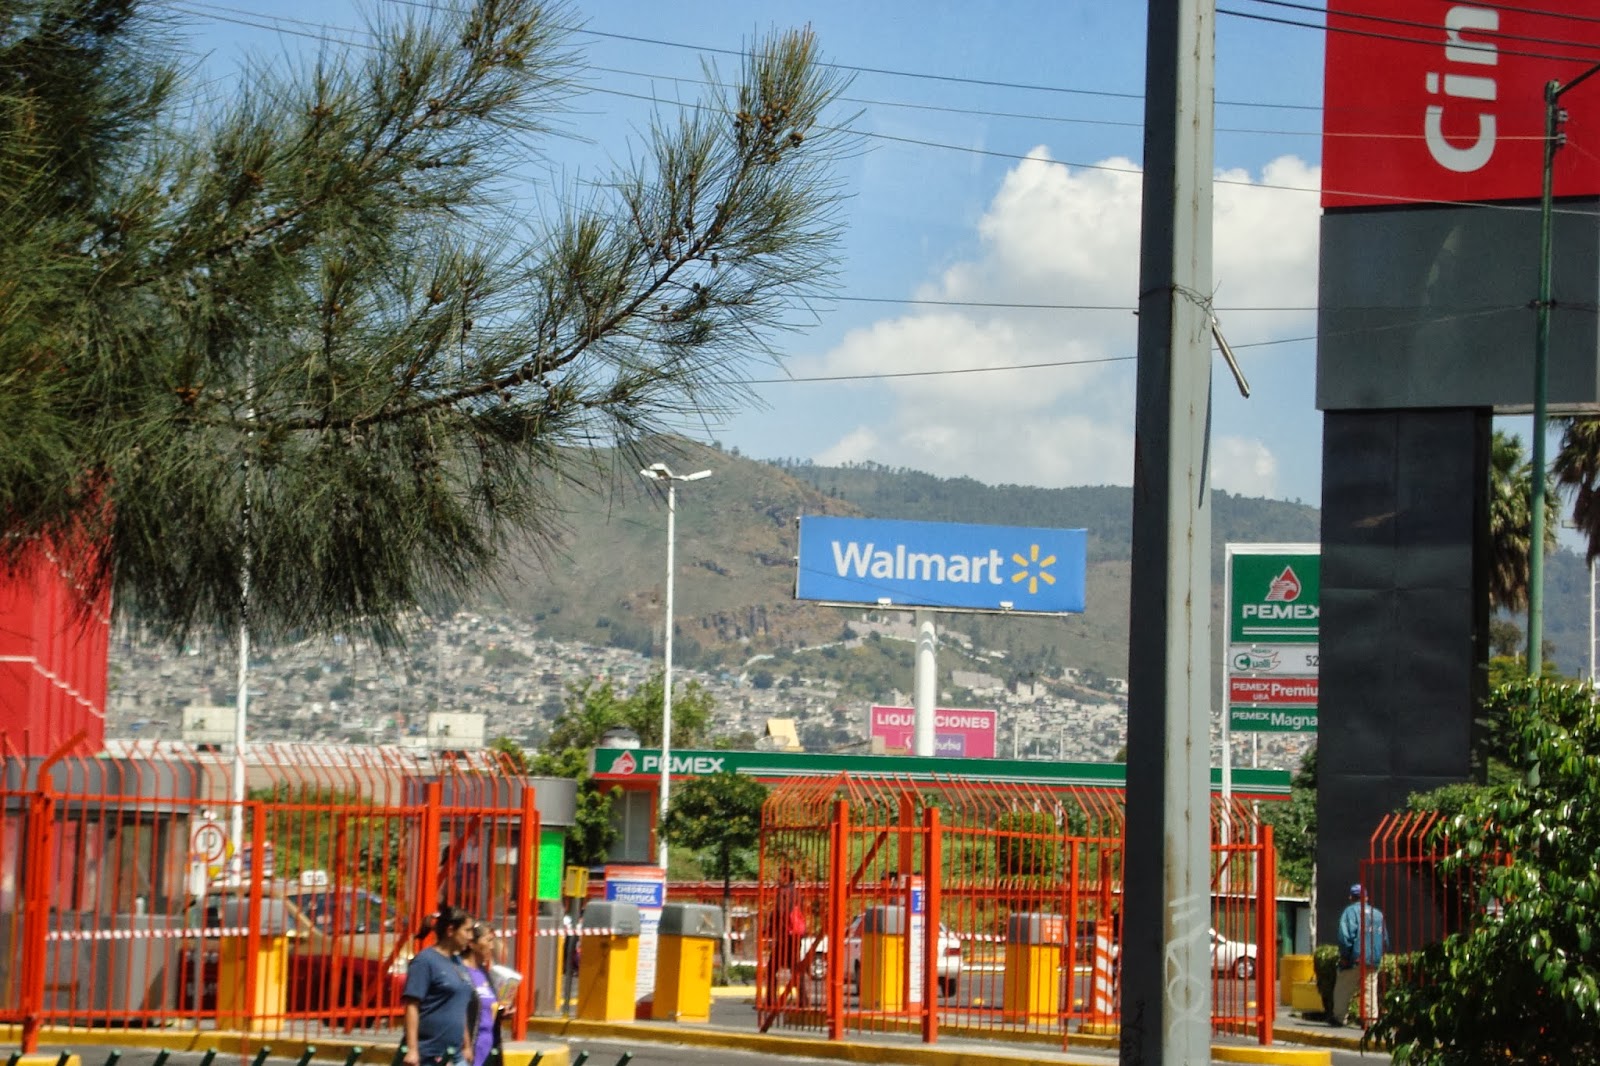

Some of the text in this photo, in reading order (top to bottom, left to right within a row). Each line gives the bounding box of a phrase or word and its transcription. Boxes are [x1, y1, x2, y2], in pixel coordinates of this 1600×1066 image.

[831, 541, 1003, 585] Walmart
[1242, 604, 1320, 619] PEMEX
[1232, 683, 1270, 691] PEMEX
[877, 713, 990, 729] LIQUICIONES
[1232, 712, 1318, 730] PEMEX Magna
[642, 756, 725, 773] PEMEX
